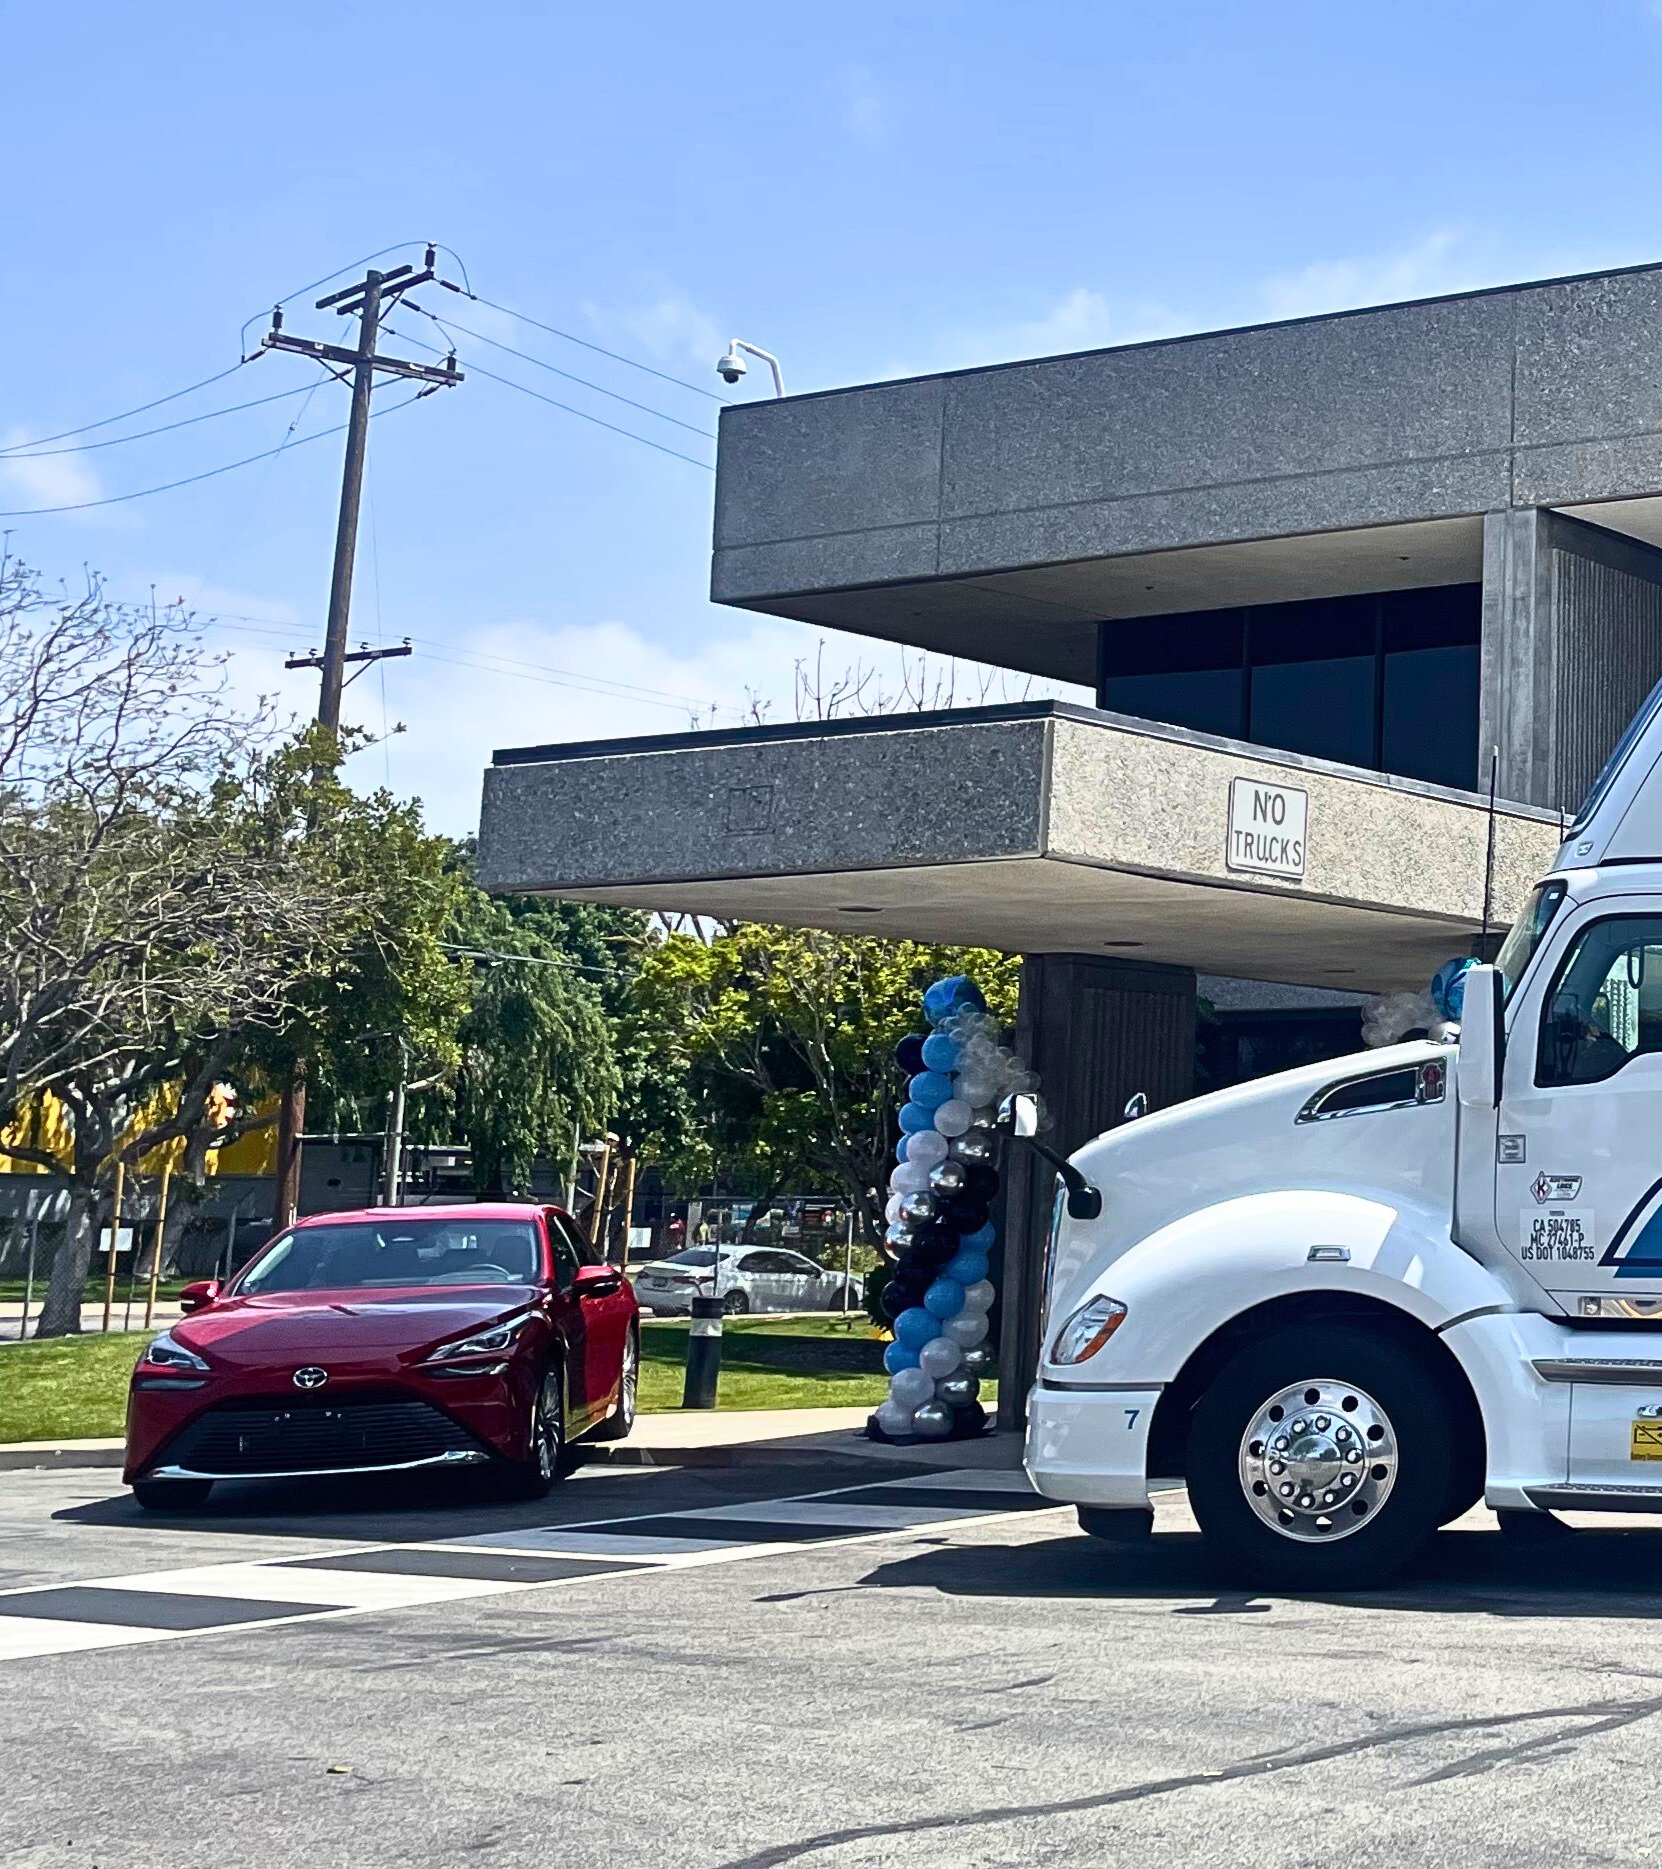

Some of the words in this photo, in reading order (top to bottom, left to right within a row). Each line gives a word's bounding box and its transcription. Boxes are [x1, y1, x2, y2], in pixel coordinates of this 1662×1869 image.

[1253, 789, 1286, 826] NO
[1234, 829, 1302, 867] TRUCKS
[1533, 1218, 1546, 1233] CA
[1547, 1218, 1581, 1233] 504785
[1530, 1232, 1545, 1247] MC
[1521, 1246, 1534, 1260] US
[1536, 1246, 1554, 1260] DOT
[1557, 1246, 1595, 1260] 1048755
[1124, 1409, 1140, 1430] 7
